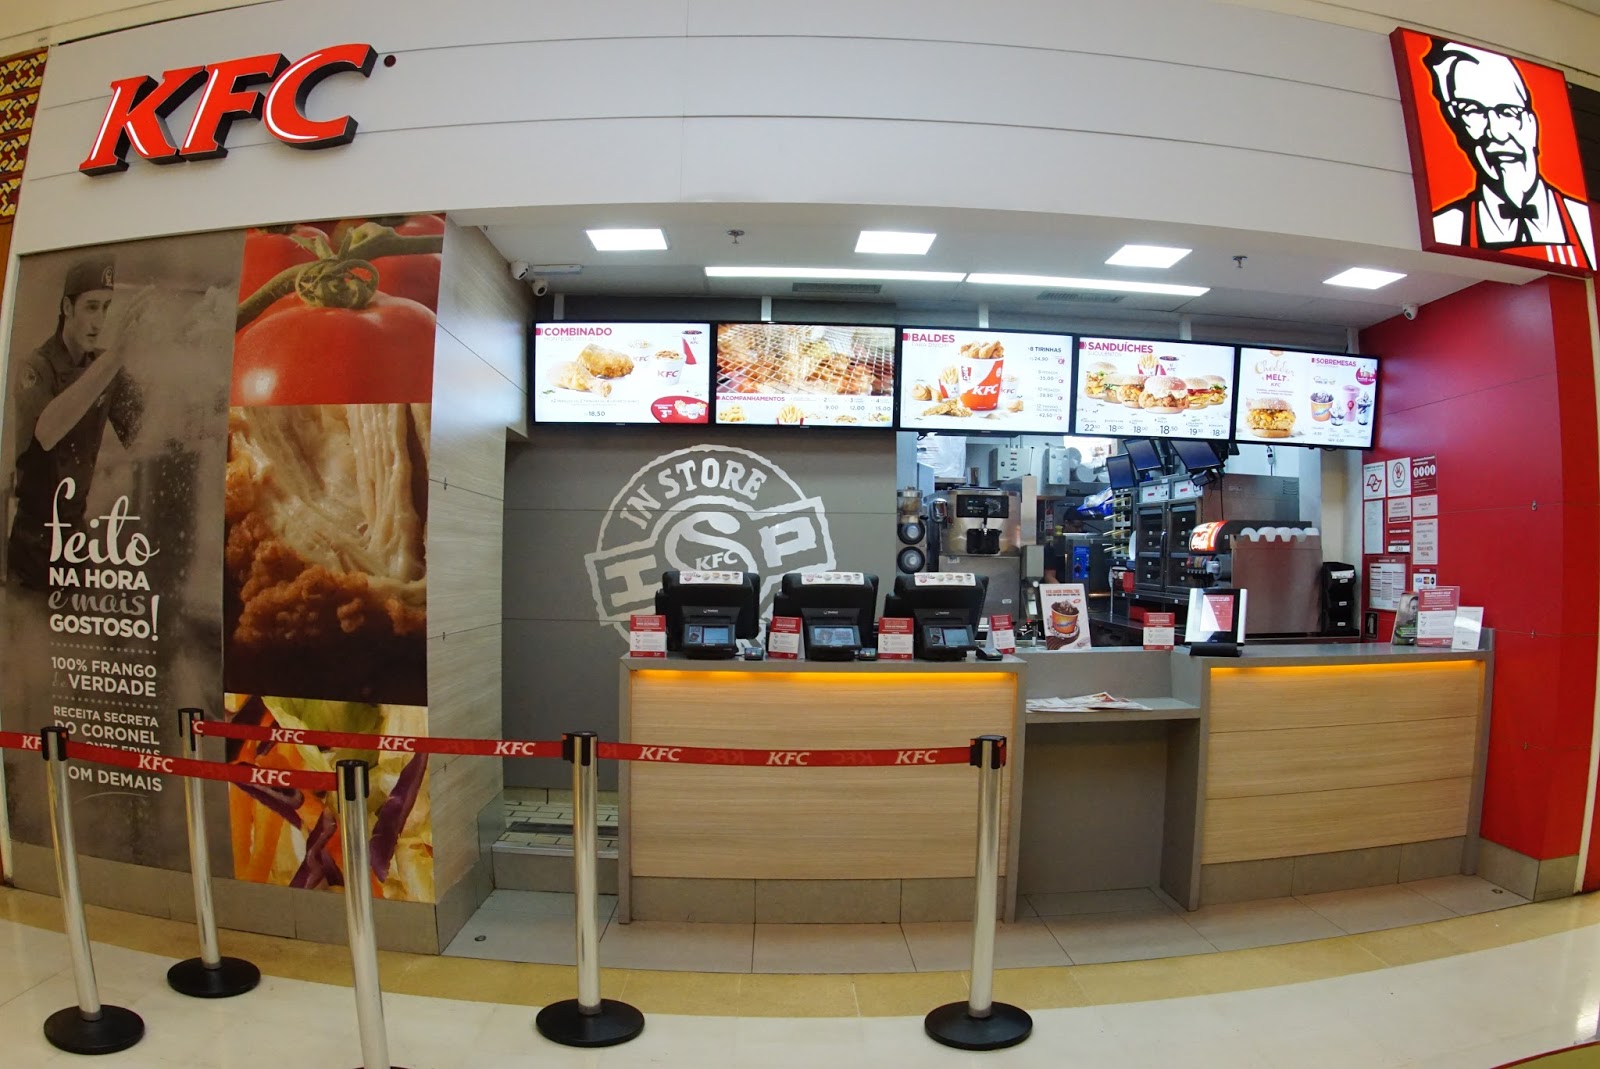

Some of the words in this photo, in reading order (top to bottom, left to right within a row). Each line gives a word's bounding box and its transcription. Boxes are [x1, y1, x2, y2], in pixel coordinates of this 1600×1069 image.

[79, 43, 378, 177] KFC
[544, 327, 612, 336] COMBINADO
[911, 333, 955, 343] BALDES
[1088, 341, 1154, 354] SANDUÍCHES
[1316, 358, 1357, 367] SOBREMESAS
[658, 370, 679, 378] KFC
[1266, 373, 1287, 382] MELT
[972, 383, 999, 396] KFC
[620, 483, 662, 530] IN
[657, 457, 768, 501] STORE
[44, 477, 160, 566] feito
[694, 550, 739, 572] KFC
[49, 567, 80, 588] NA
[85, 568, 150, 591] HORA
[72, 592, 146, 616] mais
[49, 594, 160, 641] GOSTOSO!
[51, 656, 88, 672] 100%
[92, 660, 157, 678] FRANGO
[68, 673, 157, 698] VERDADE
[53, 706, 101, 721] RECEITA
[104, 712, 159, 728] SECRETA
[21, 735, 42, 750] KF
[81, 723, 160, 746] CORONEL
[270, 729, 304, 743] KFC
[377, 736, 415, 751] KFC
[493, 741, 535, 755] KFC
[638, 746, 682, 762] KFC
[766, 752, 811, 765] KFC
[894, 750, 938, 764] KFC
[68, 766, 92, 782] OM
[98, 770, 163, 792] DEMAIS
[137, 754, 174, 773] KFC
[250, 768, 291, 786] KFC
